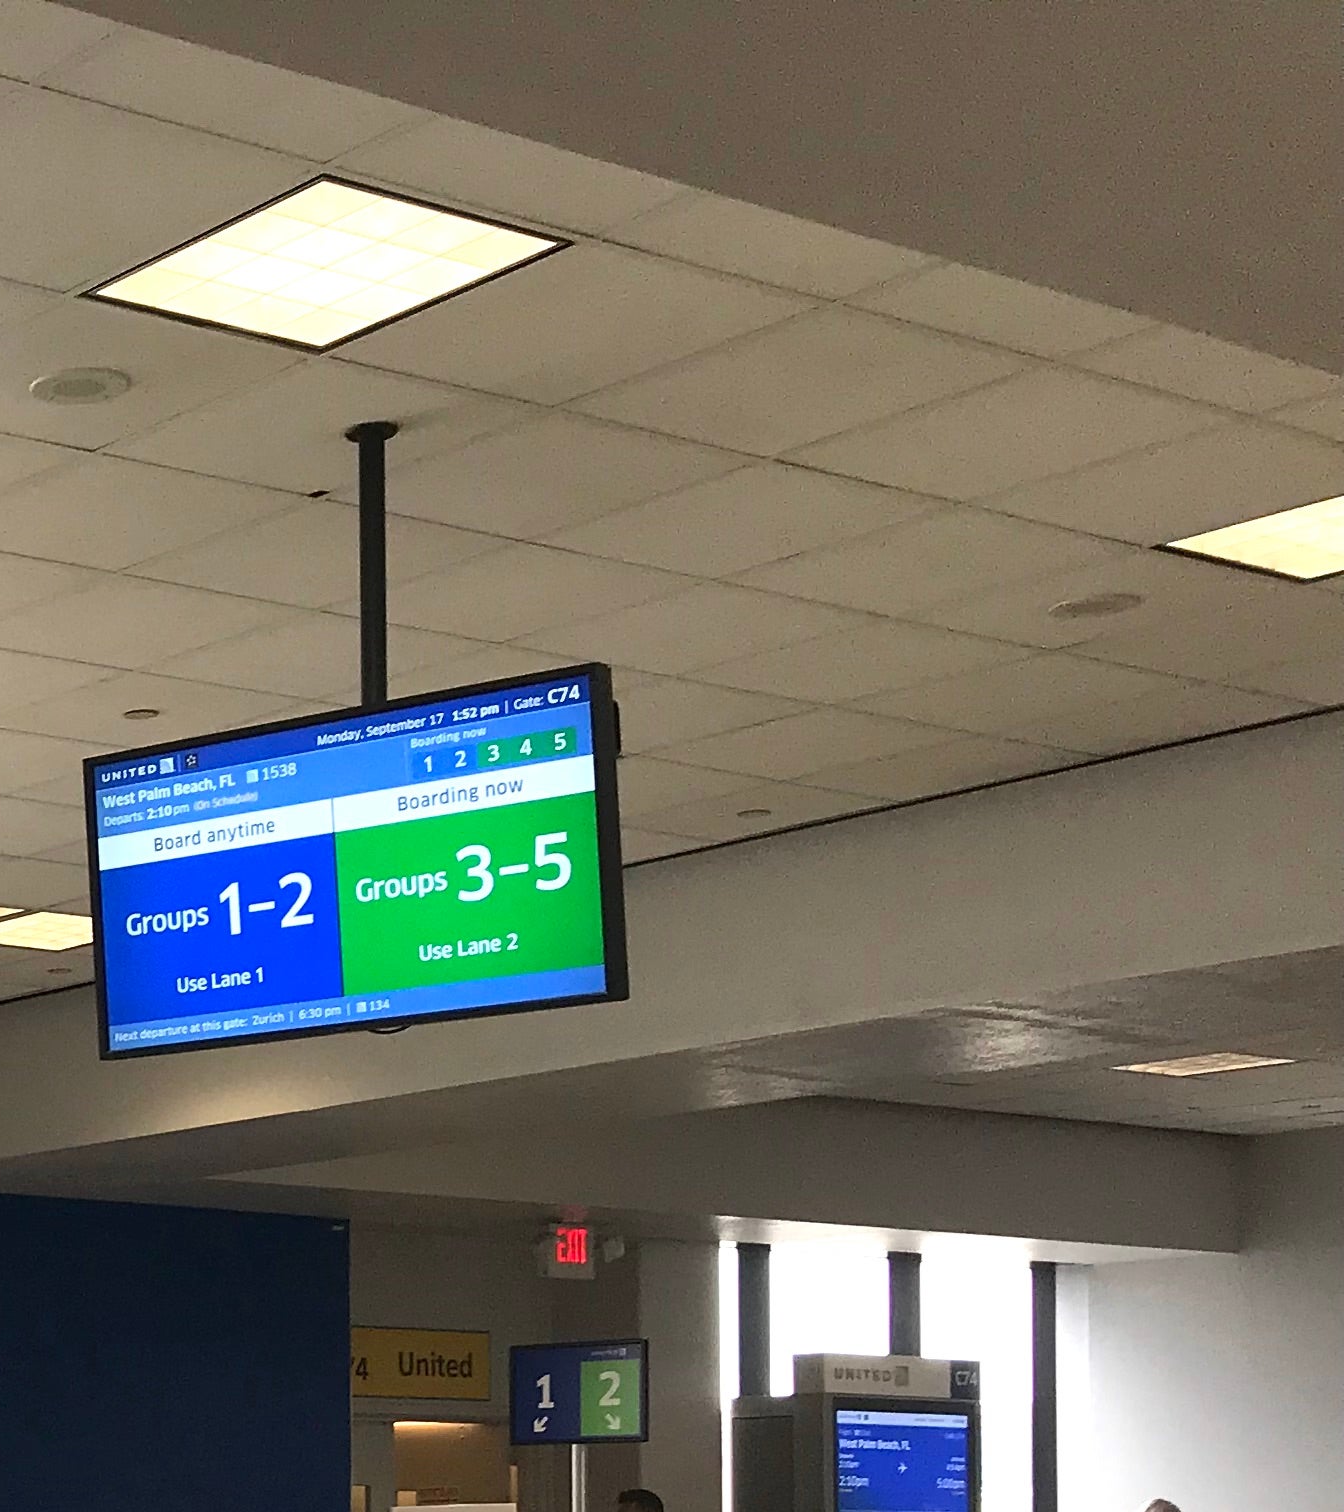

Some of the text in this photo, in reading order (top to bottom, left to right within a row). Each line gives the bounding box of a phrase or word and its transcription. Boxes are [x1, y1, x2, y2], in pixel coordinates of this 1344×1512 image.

[513, 685, 581, 710] Gate: C74
[316, 704, 500, 746] Monday, September 17 1:52 pm
[410, 726, 488, 750] Boarding now
[424, 733, 567, 773] 1 2 3 4 5
[101, 764, 157, 783] UNITED
[262, 762, 297, 781] 1538
[102, 774, 236, 809] West Palm Beach, FL
[397, 779, 524, 811] Boarding now
[154, 820, 276, 852] Board anytime
[355, 865, 449, 903] Groups
[125, 900, 210, 937] Groups
[418, 933, 520, 963] Use Lane 2
[176, 967, 265, 994] Use Lane 1
[115, 1030, 139, 1043] Next
[140, 1024, 189, 1041] departure
[189, 1023, 201, 1034] at
[202, 1019, 222, 1032] this
[324, 1005, 342, 1018] pm
[556, 1227, 588, 1264] EXIT
[398, 1351, 473, 1378] United
[834, 1367, 892, 1383] UNITED
[955, 1371, 978, 1386] C74
[536, 1374, 555, 1409] 1
[599, 1370, 621, 1407] 2
